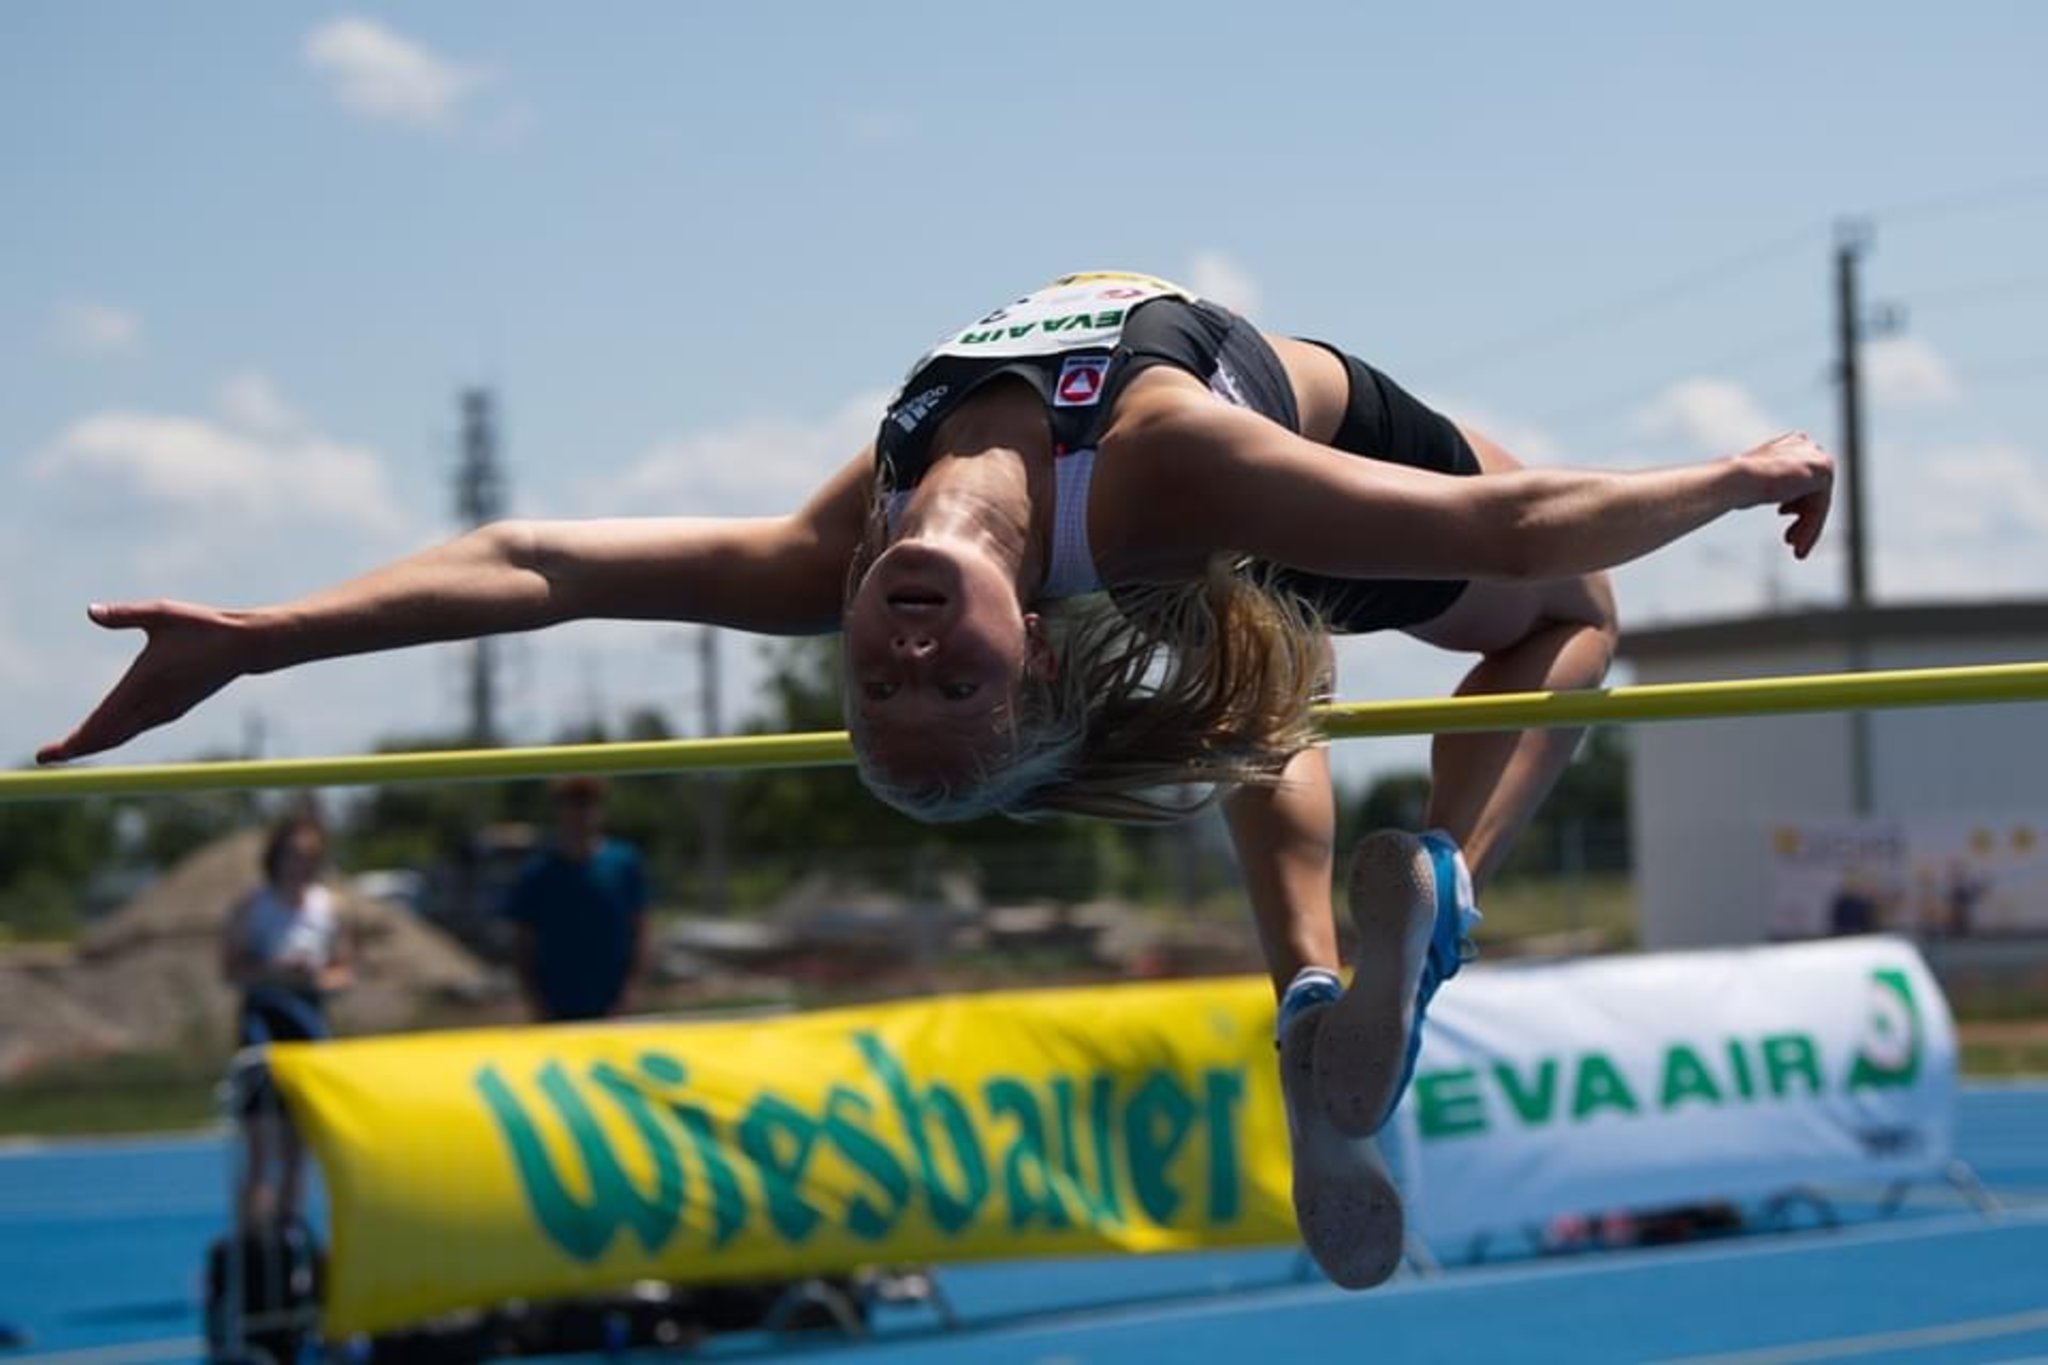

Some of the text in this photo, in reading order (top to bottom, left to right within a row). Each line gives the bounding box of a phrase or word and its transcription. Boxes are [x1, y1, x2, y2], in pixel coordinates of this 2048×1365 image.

[960, 323, 1036, 343] AIR
[1042, 310, 1124, 332] EVA
[1414, 1035, 1824, 1139] EVA AIR
[475, 1033, 1244, 1262] Wiesbauer
